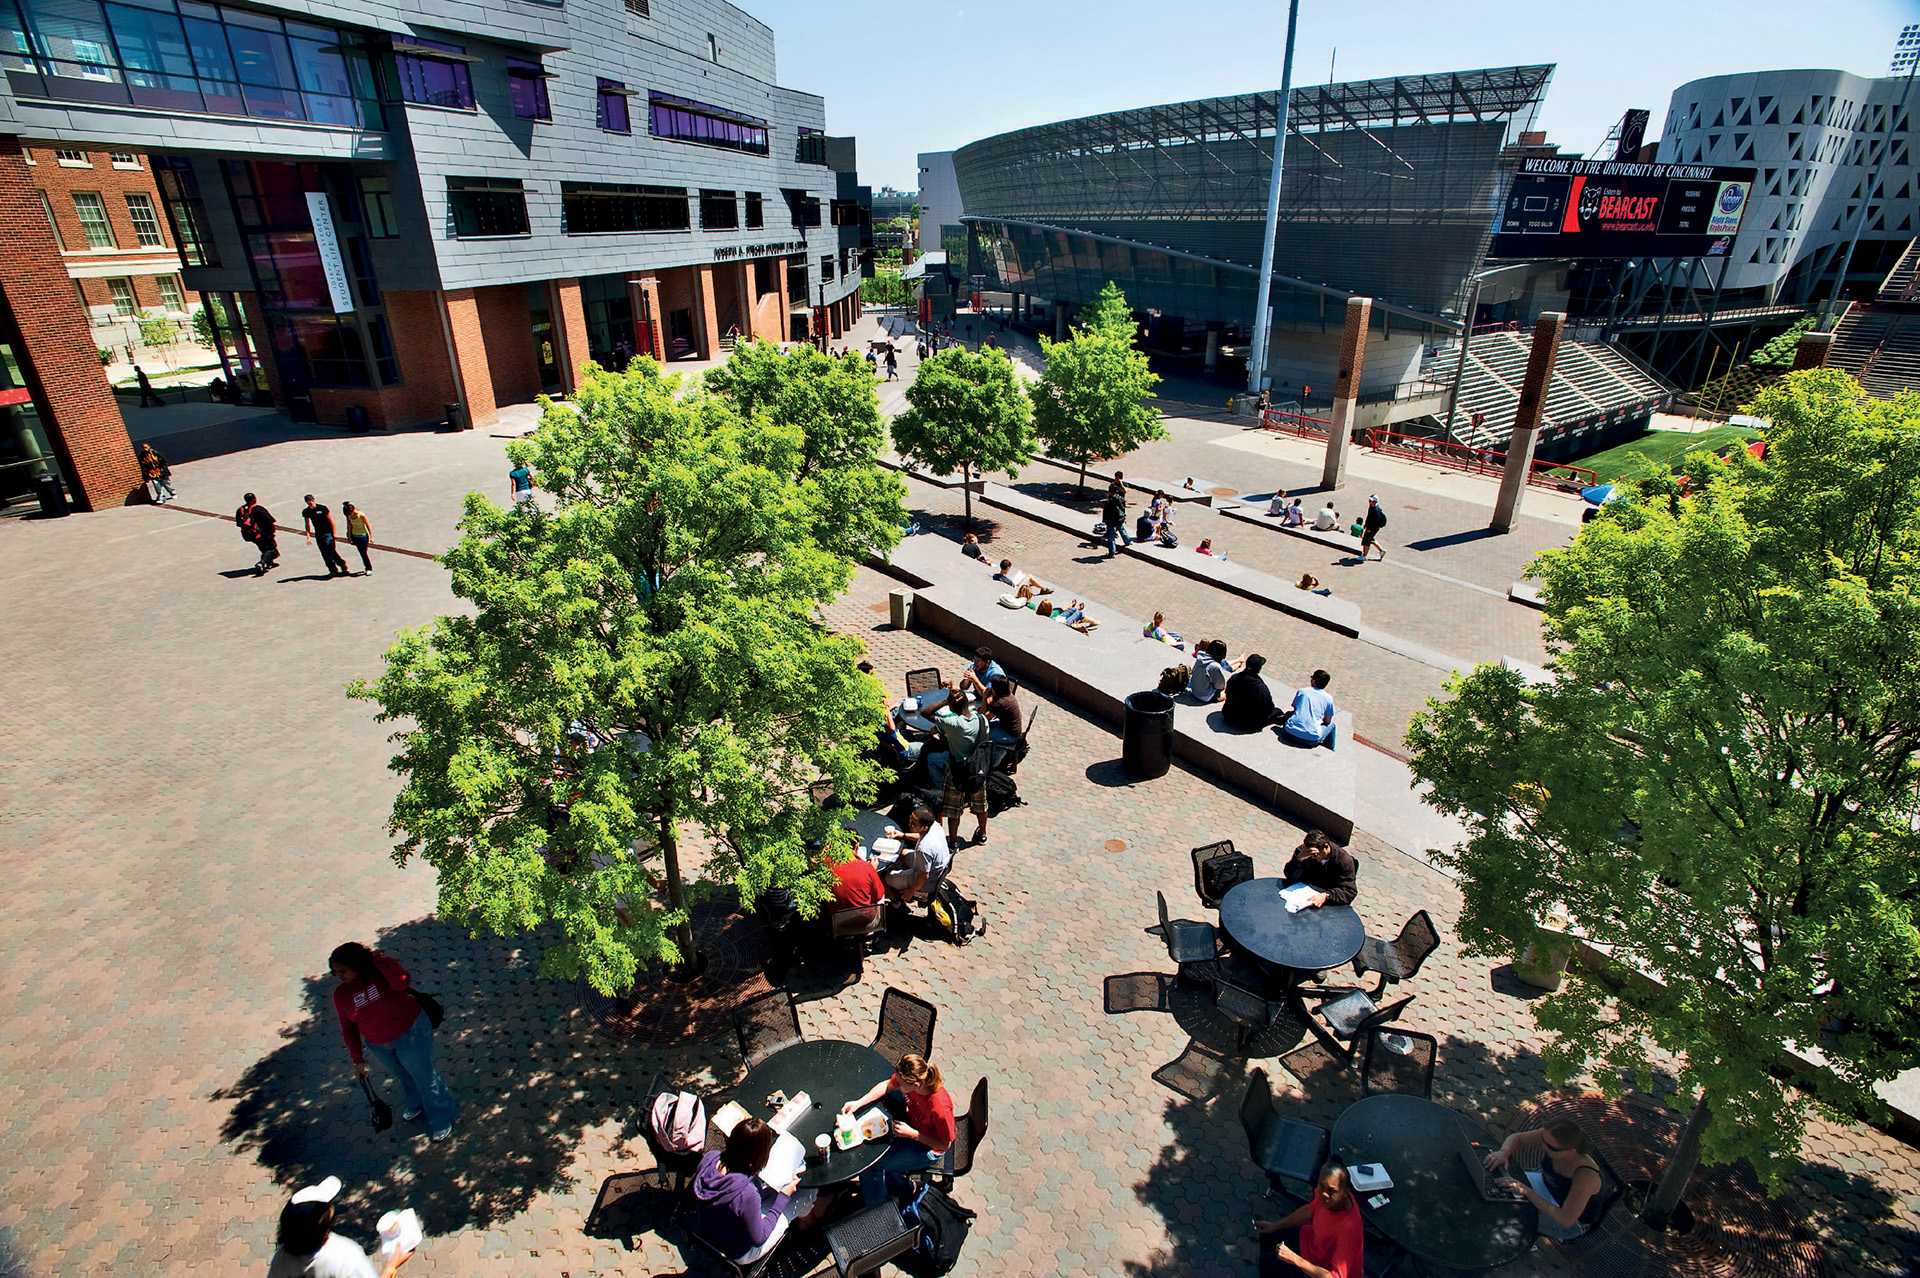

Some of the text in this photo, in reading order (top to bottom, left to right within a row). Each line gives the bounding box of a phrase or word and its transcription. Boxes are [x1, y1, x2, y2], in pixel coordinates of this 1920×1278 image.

[1525, 158, 1714, 179] WELCOME TO THE UNIVERSITY OF CINCINNATI
[1598, 196, 1658, 219] BEARCAST
[318, 199, 350, 306] STUDENT LIFE CENTER
